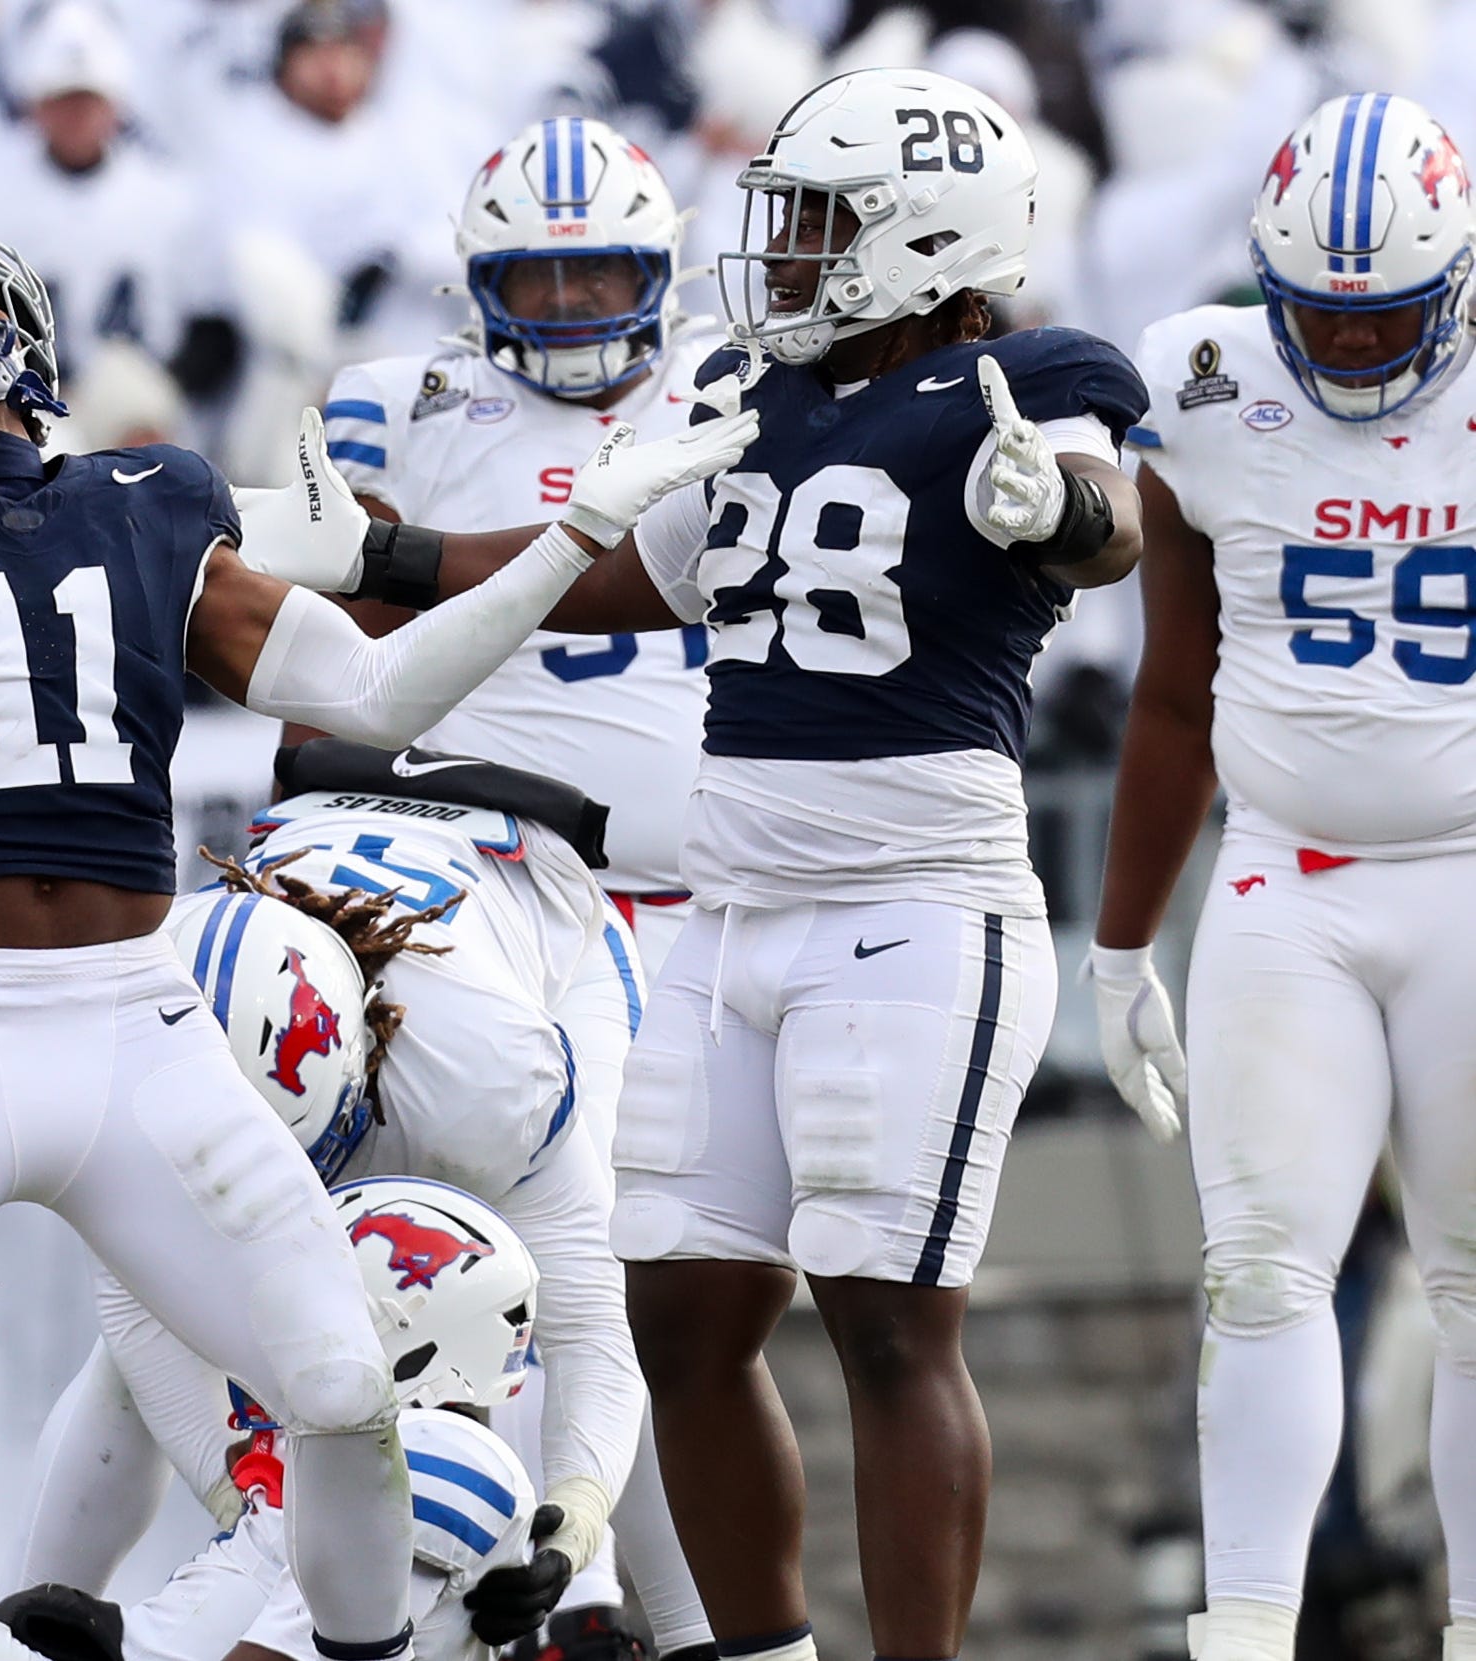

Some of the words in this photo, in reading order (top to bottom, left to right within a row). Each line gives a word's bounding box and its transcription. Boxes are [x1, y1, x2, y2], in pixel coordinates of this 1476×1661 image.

[895, 108, 984, 174] 28
[1330, 279, 1368, 292] SMU
[1244, 407, 1285, 422] ACC
[307, 482, 322, 522] PENN
[1314, 499, 1459, 541] SMU
[696, 464, 912, 677] 28
[1280, 543, 1476, 685] 59
[325, 796, 471, 821] DOUGLAS
